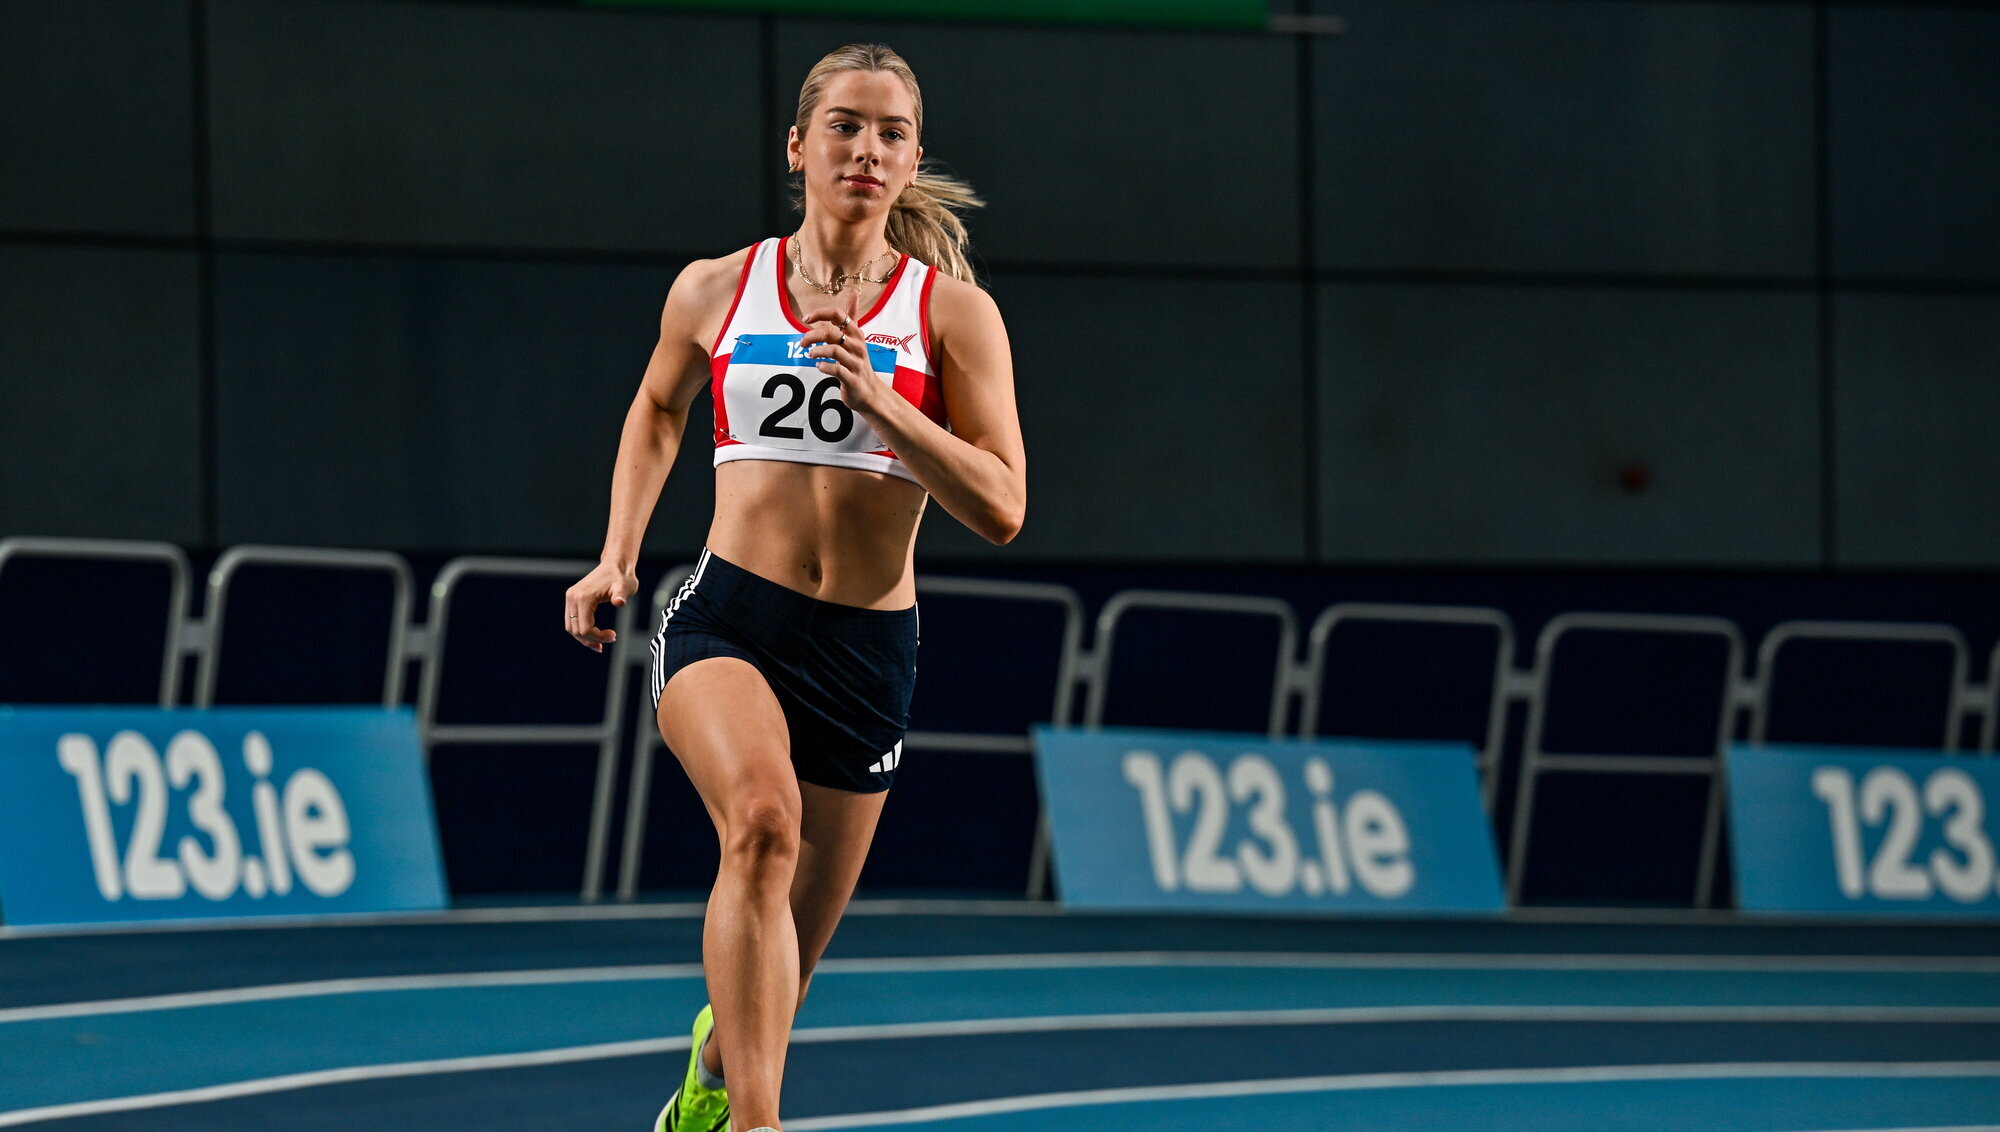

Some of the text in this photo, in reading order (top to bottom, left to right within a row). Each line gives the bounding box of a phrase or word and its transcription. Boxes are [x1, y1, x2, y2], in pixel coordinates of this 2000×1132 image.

[759, 373, 854, 443] 26
[57, 730, 356, 901] 123.ie
[1122, 750, 1416, 897] 123.ie
[1811, 766, 2000, 902] 123
